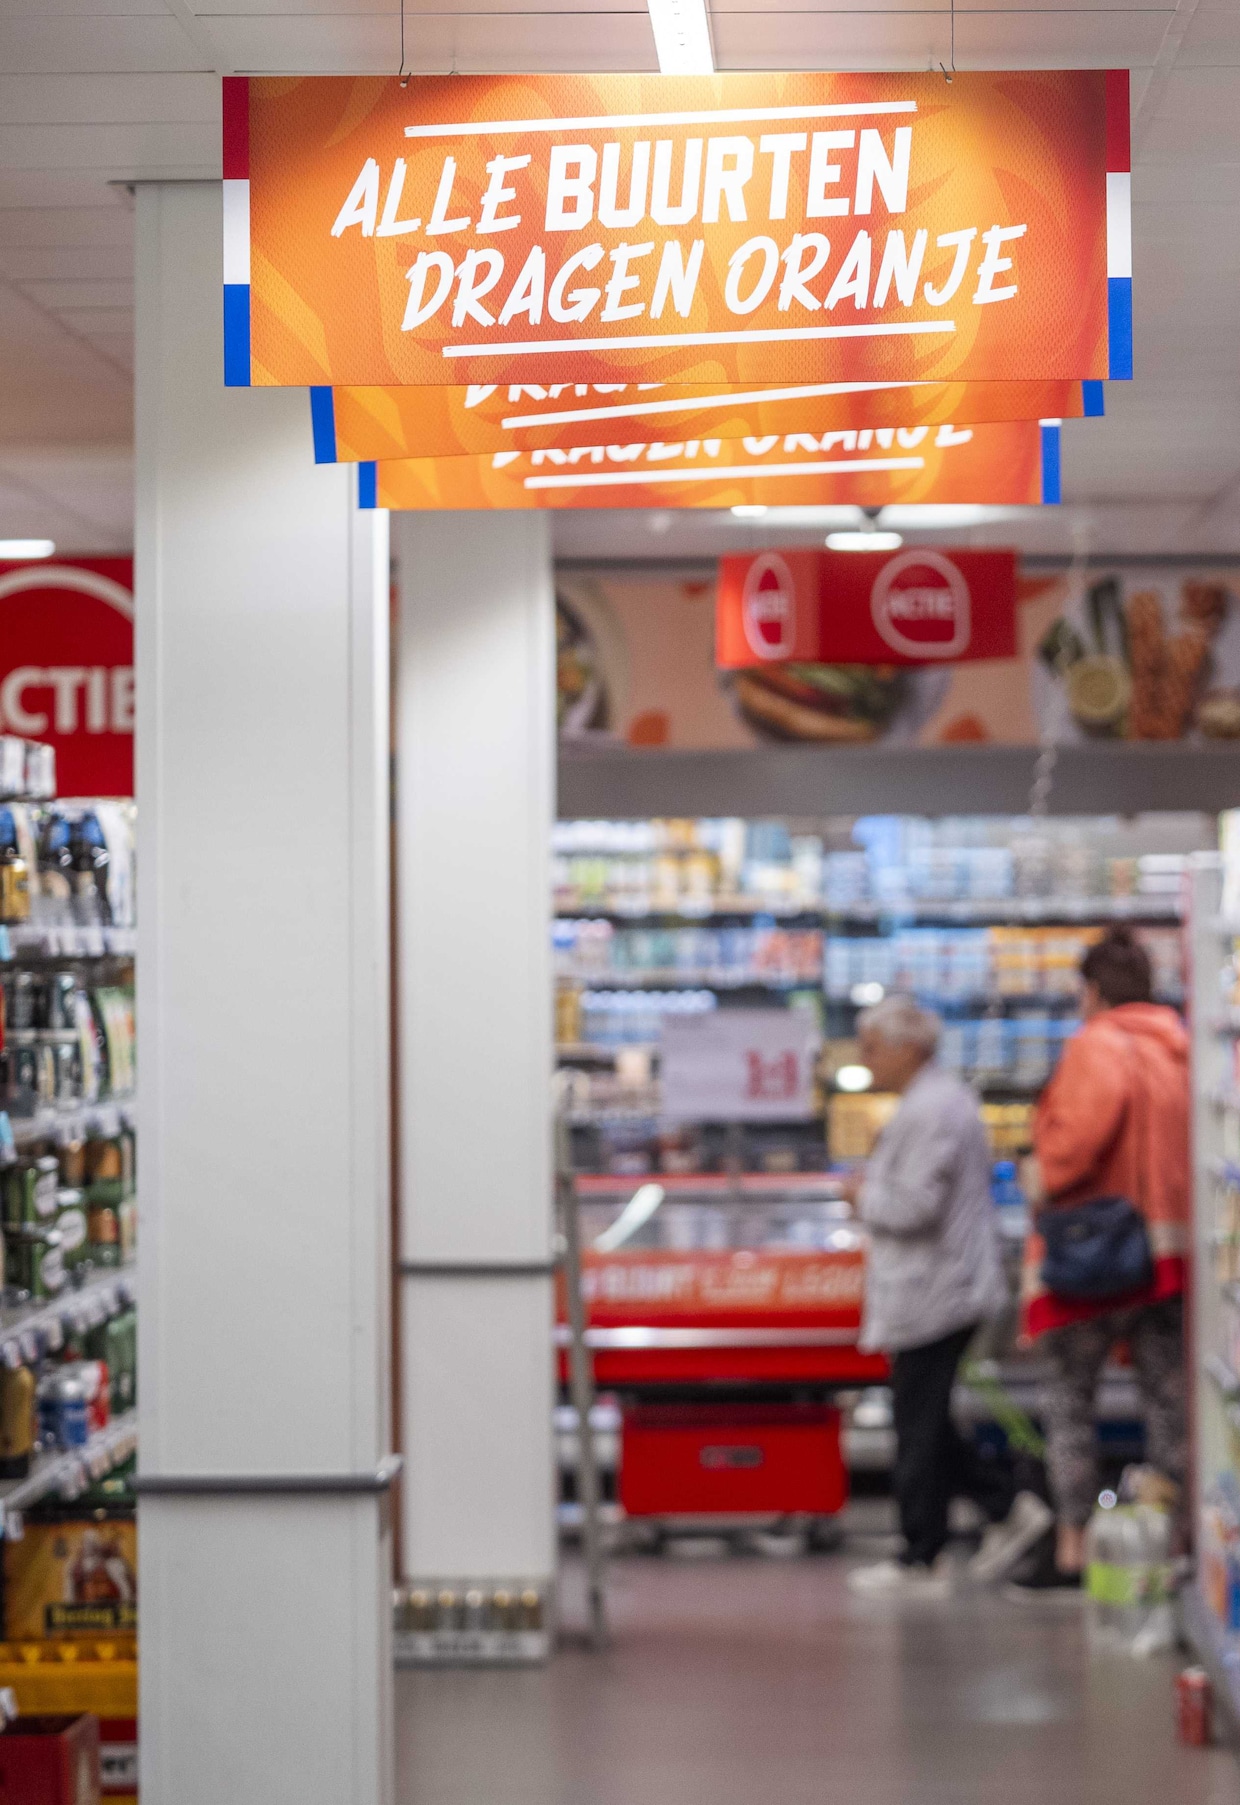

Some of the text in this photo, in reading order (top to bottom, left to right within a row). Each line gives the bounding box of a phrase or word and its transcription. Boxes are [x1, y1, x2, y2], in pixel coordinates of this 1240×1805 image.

[331, 126, 913, 238] ALLE BUURTEN
[401, 224, 1028, 332] DRAGEN ORANJE
[0, 665, 133, 736] CTIE
